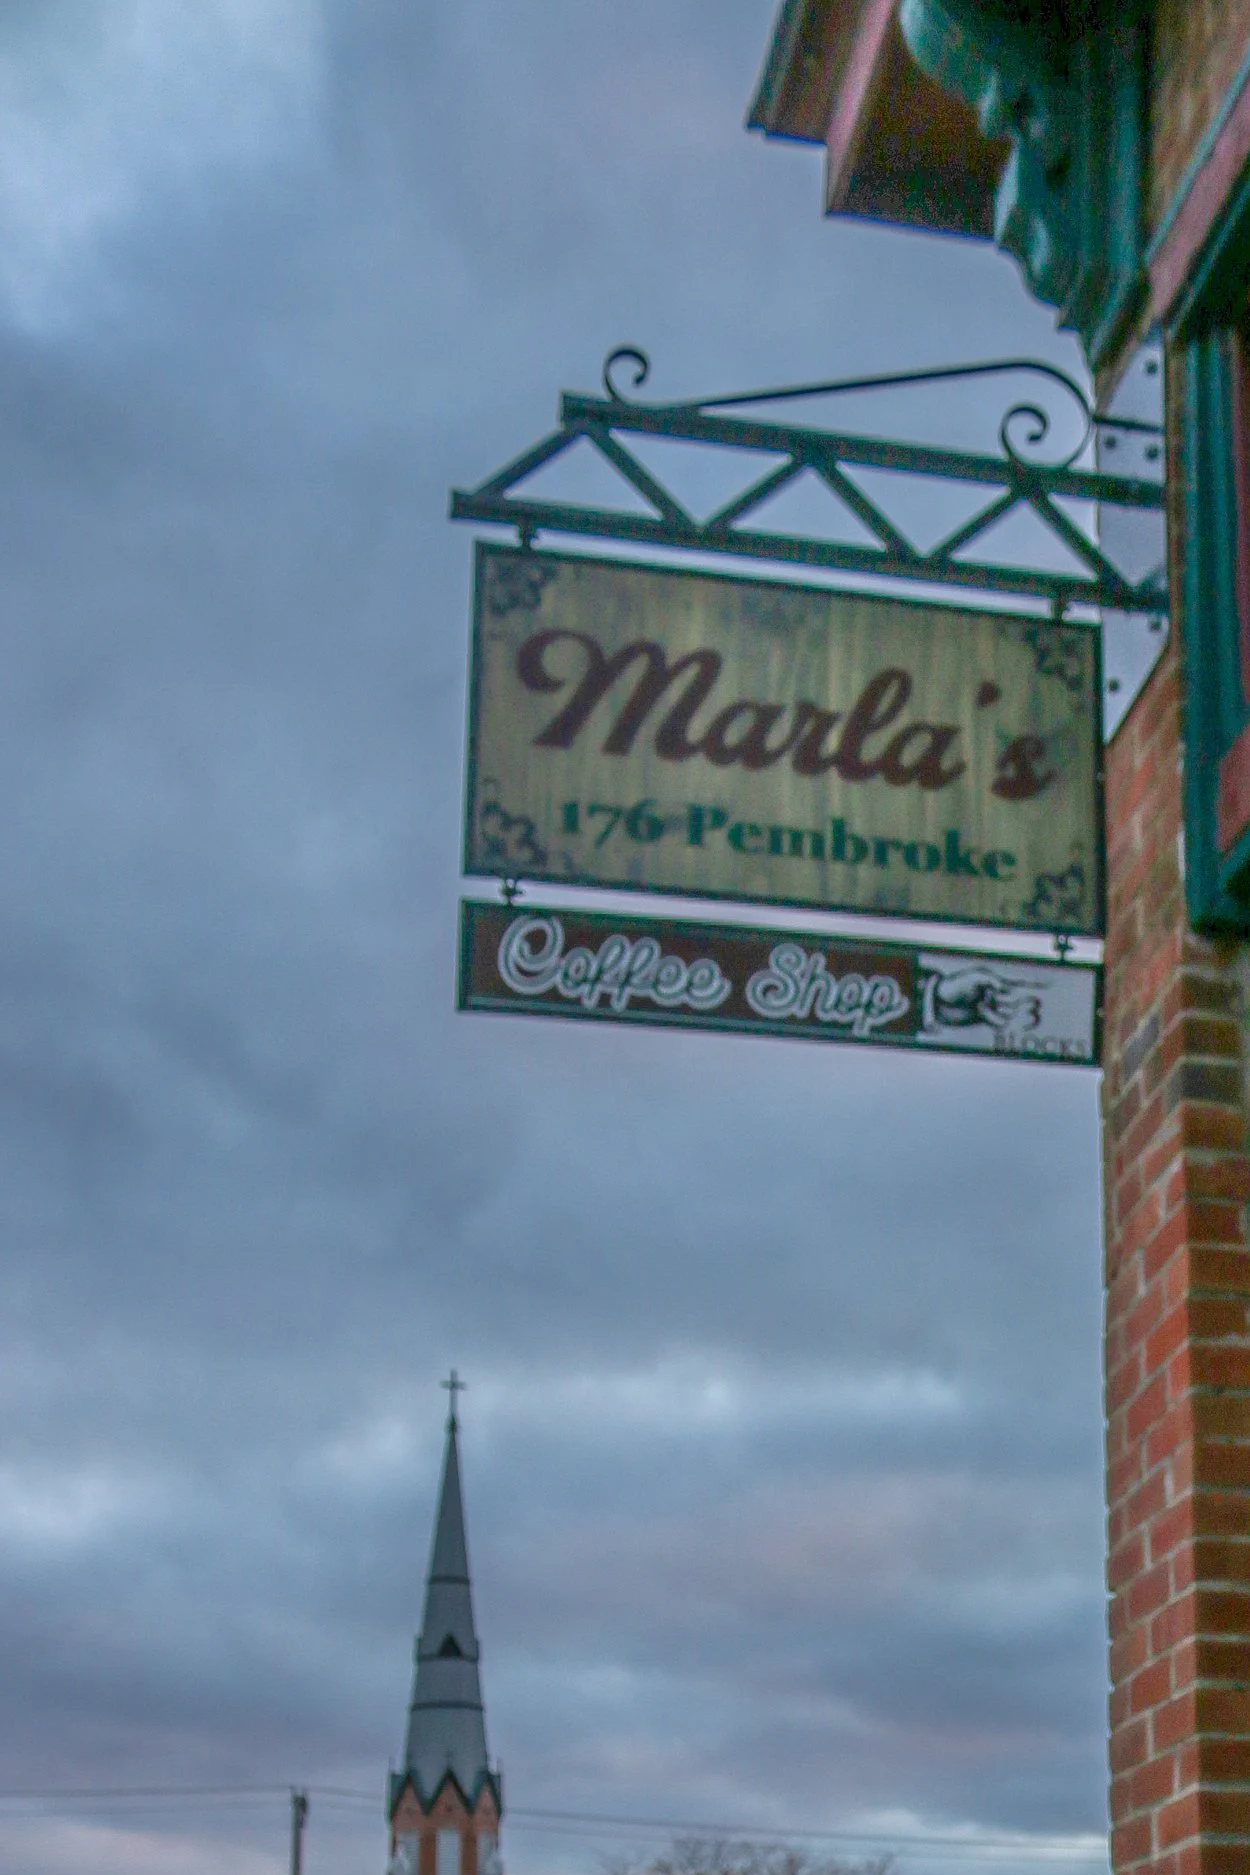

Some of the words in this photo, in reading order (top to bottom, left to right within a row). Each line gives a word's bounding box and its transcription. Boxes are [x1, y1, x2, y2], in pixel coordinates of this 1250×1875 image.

[516, 629, 1057, 800] Marla's
[558, 799, 664, 848] 176
[686, 801, 1017, 881] Pembroke
[498, 916, 731, 1012] Coffee
[746, 943, 909, 1036] Shop
